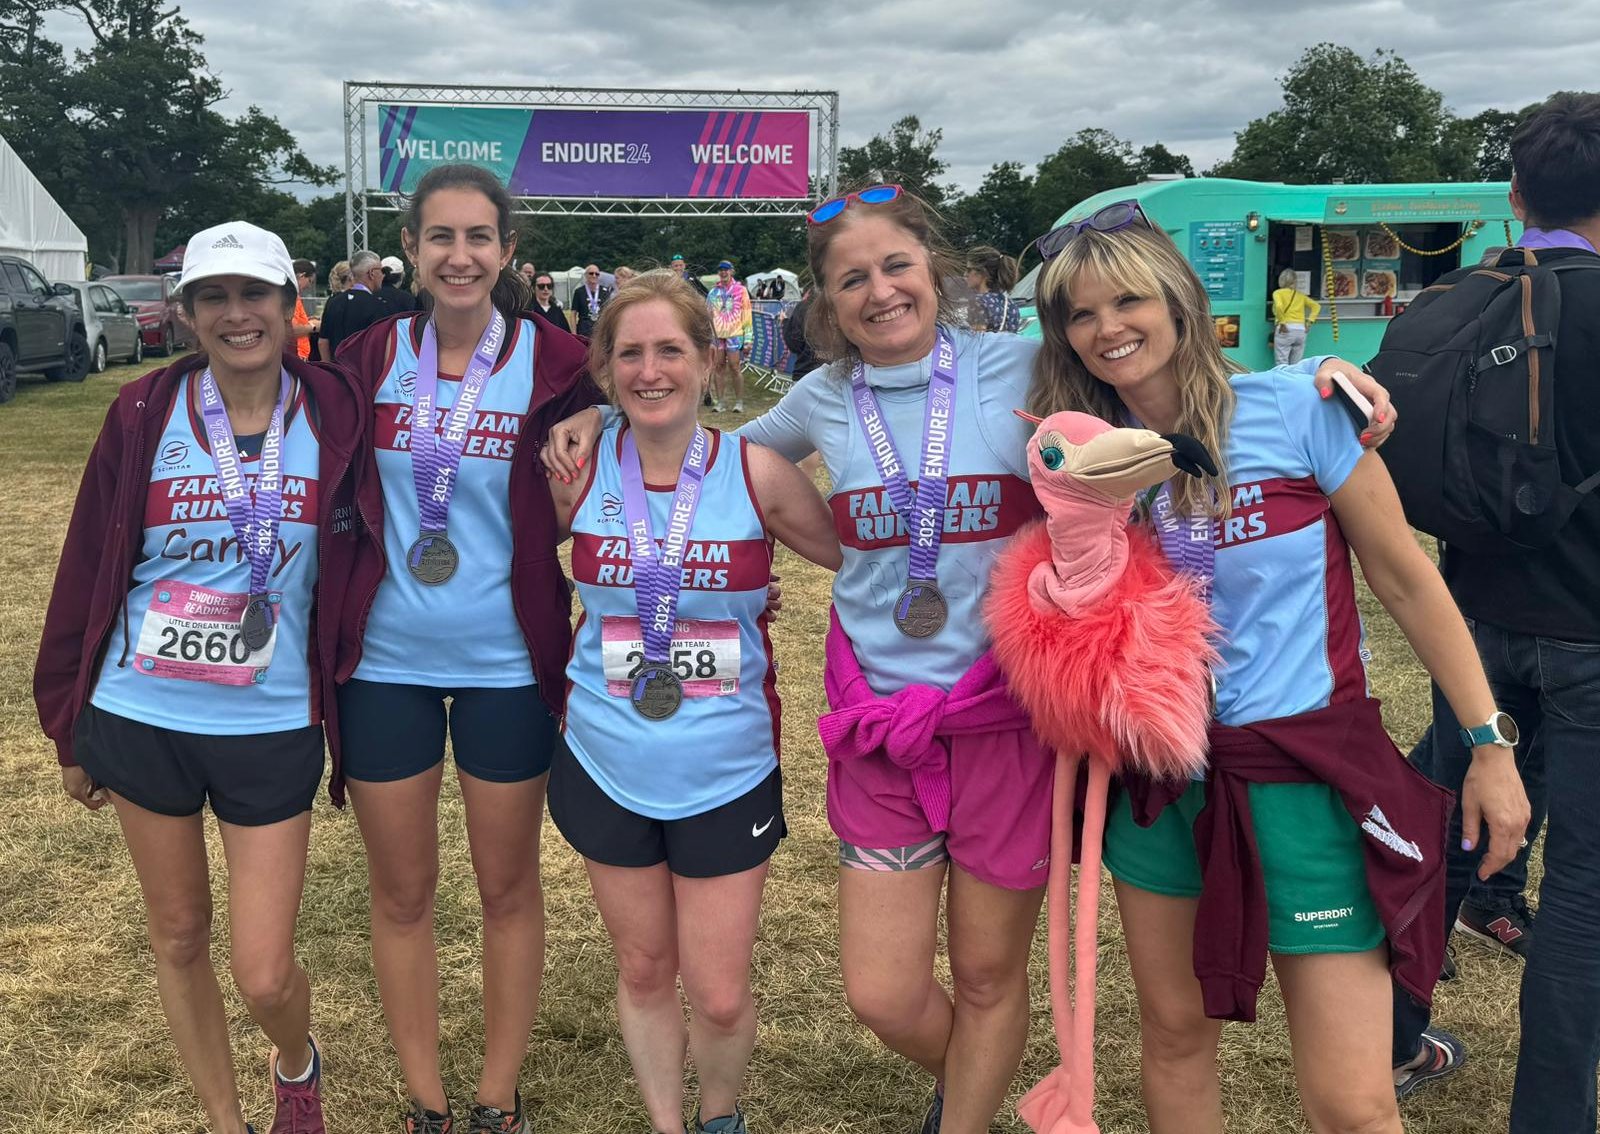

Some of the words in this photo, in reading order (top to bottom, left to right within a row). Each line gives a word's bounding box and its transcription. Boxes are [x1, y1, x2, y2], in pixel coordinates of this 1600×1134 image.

[396, 139, 502, 162] WELCOME
[541, 142, 652, 164] ENDURE24
[690, 143, 794, 165] WELCOME
[416, 394, 431, 428] TEAM
[446, 366, 489, 441] ENDURE24
[260, 408, 281, 491] ENDURE24
[857, 391, 900, 478] ENDURE24
[924, 386, 952, 478] ENDURE24
[209, 418, 245, 499] ENDURE24
[431, 467, 452, 502] 2024
[258, 518, 273, 555] 2024
[631, 518, 651, 557] TEAM
[663, 482, 697, 566] ENDURE24
[918, 507, 937, 547] 2024
[160, 528, 302, 578] Cany
[596, 563, 729, 589] RUERS
[168, 617, 191, 629] LITTLE
[192, 622, 220, 630] DREAM
[221, 623, 242, 631] TEAM
[183, 602, 231, 615] READING
[653, 594, 673, 632] 2024
[157, 627, 251, 665] 2660
[625, 649, 717, 681] 258
[1294, 906, 1354, 922] SUPERDRY
